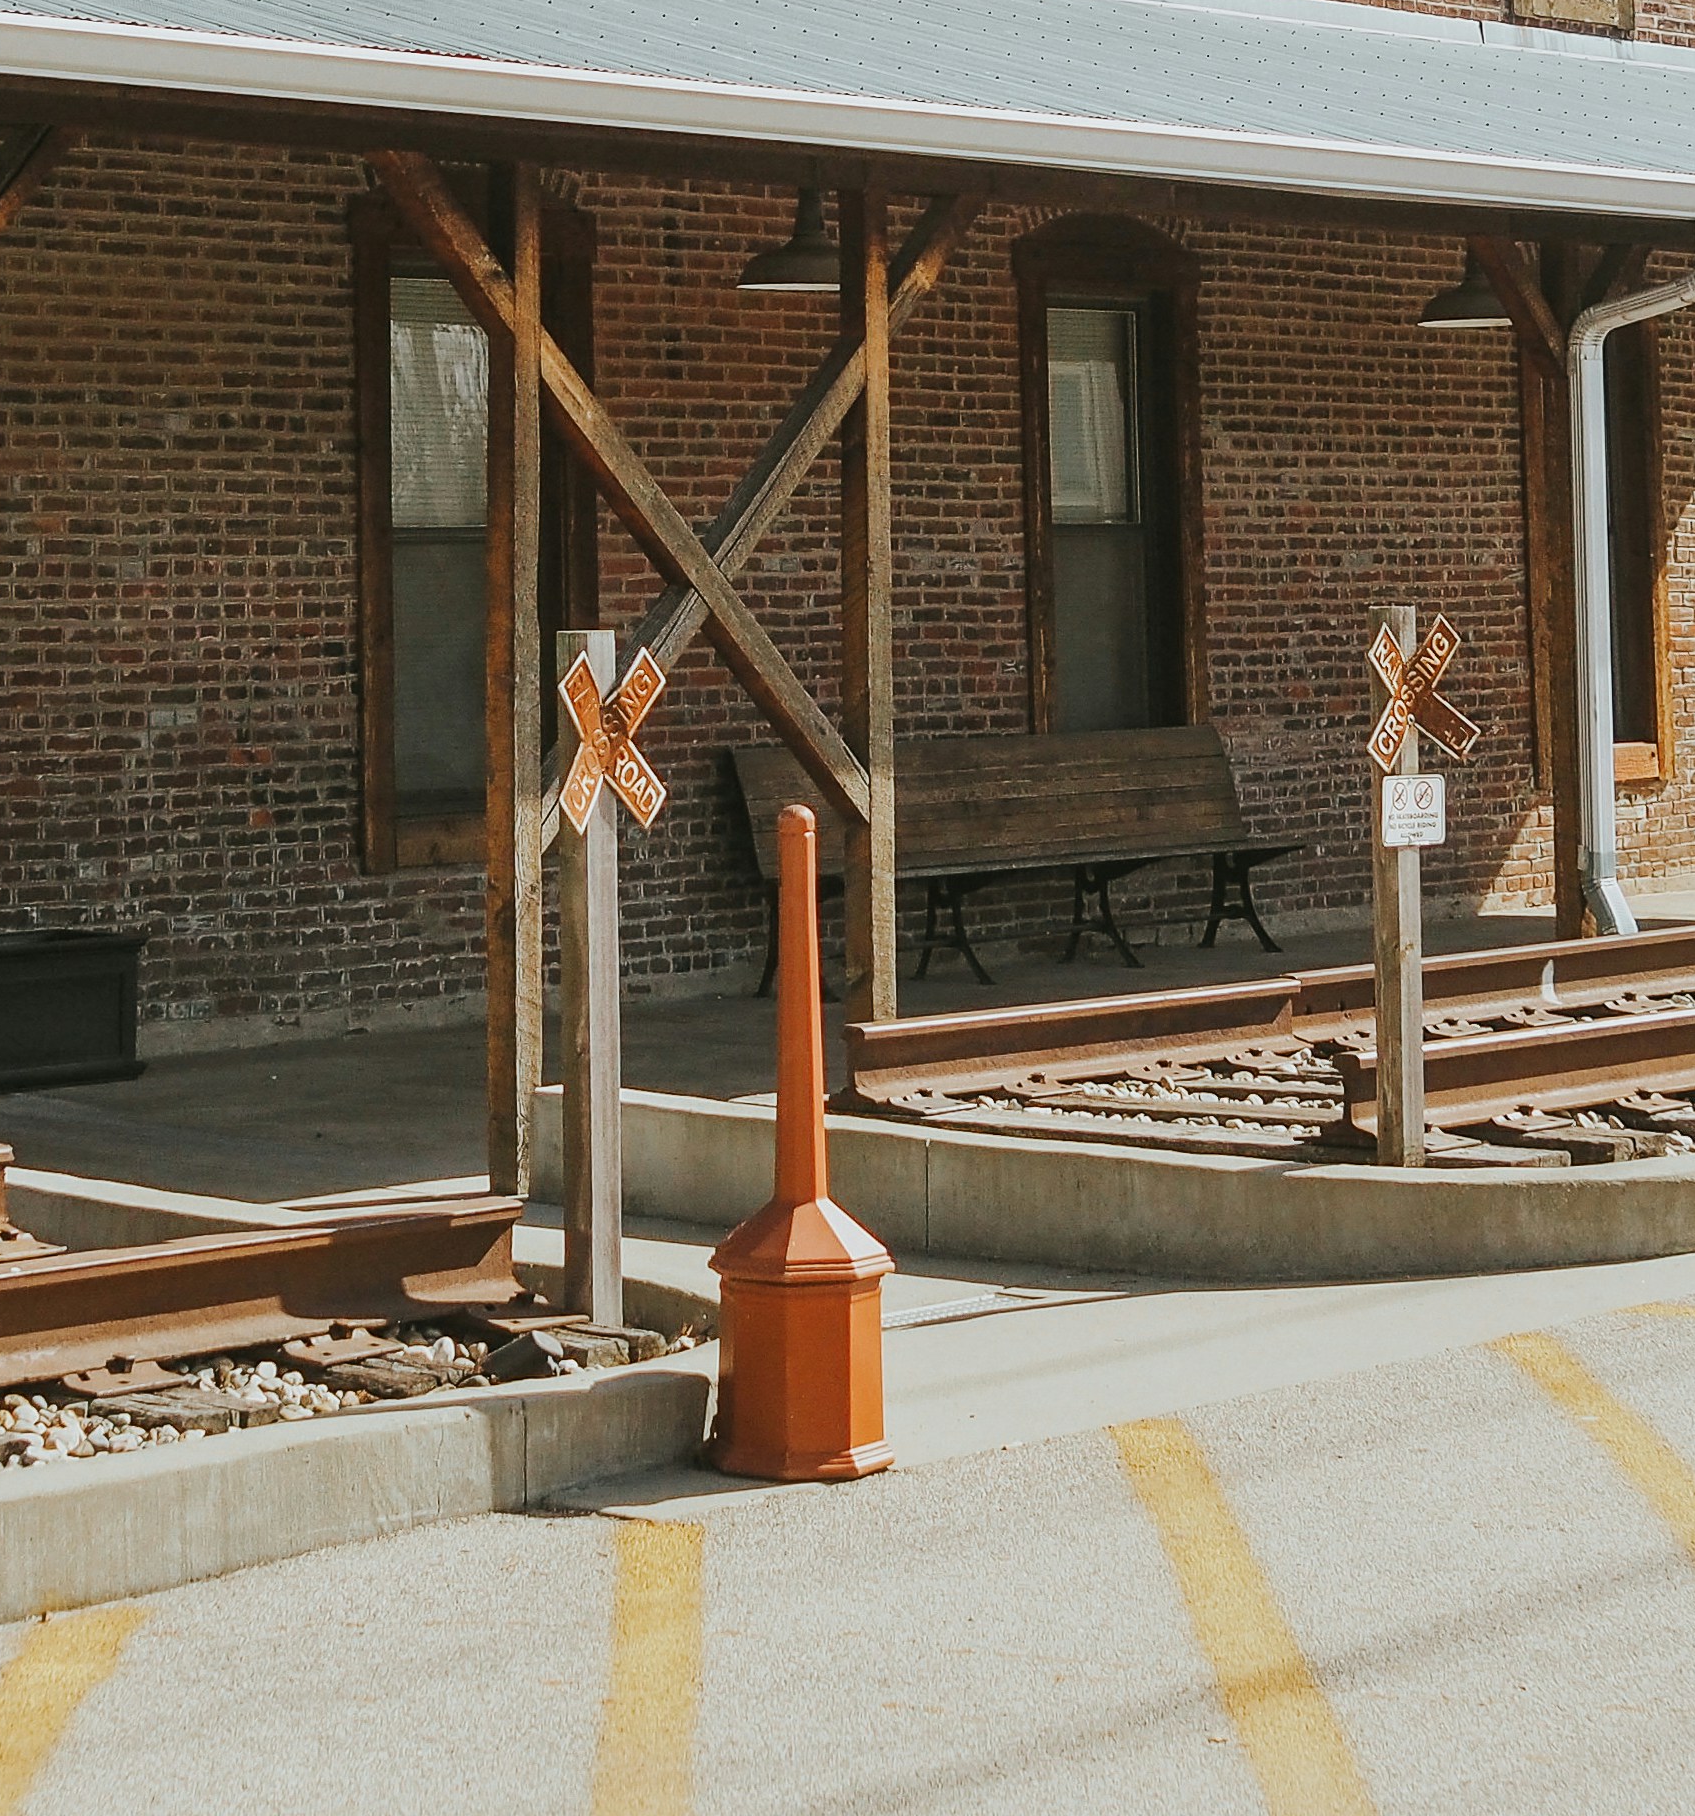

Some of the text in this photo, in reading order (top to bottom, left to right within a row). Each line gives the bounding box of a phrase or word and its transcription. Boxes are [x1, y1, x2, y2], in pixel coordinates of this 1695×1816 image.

[571, 669, 652, 813] CROSSING
[1377, 631, 1450, 756] CROSSING
[614, 745, 657, 813] ROAD
